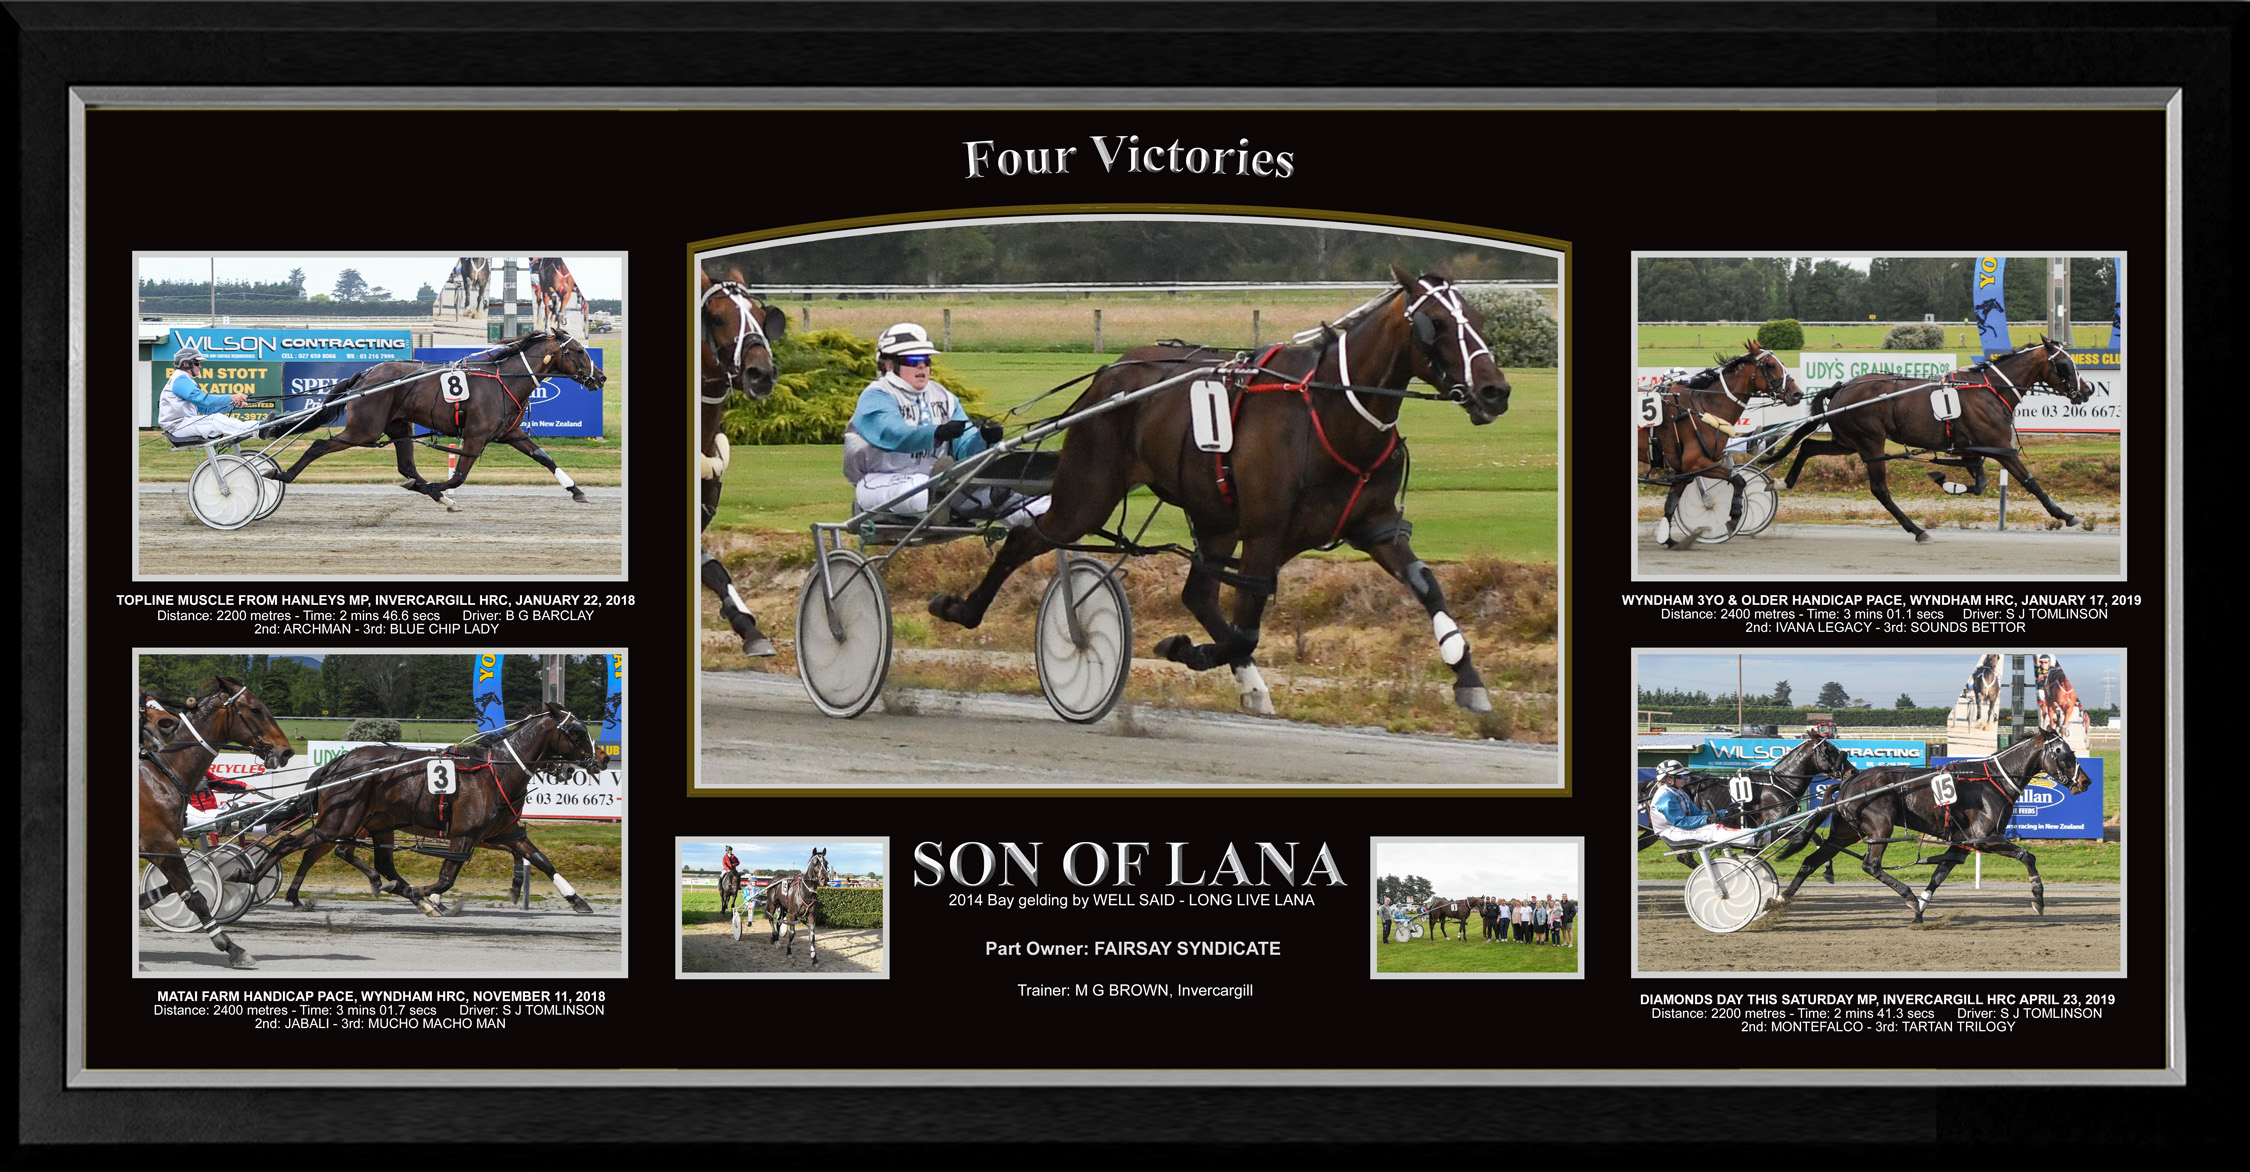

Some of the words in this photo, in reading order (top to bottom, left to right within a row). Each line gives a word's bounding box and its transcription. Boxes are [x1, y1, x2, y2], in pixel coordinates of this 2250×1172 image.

[174, 330, 276, 360] WILSON
[281, 338, 406, 349] CONTRACTING
[217, 368, 268, 379] STOTT
[1806, 358, 1845, 380] UDY'S
[447, 375, 463, 396] 8
[1642, 397, 1657, 421] 5
[1944, 394, 1951, 414] 1
[555, 420, 582, 428] Zealand
[1209, 393, 1219, 441] 1
[433, 765, 449, 789] 3
[536, 793, 551, 805] 03
[555, 793, 580, 805] 206
[583, 793, 614, 806] 6673
[1935, 777, 1955, 801] 15
